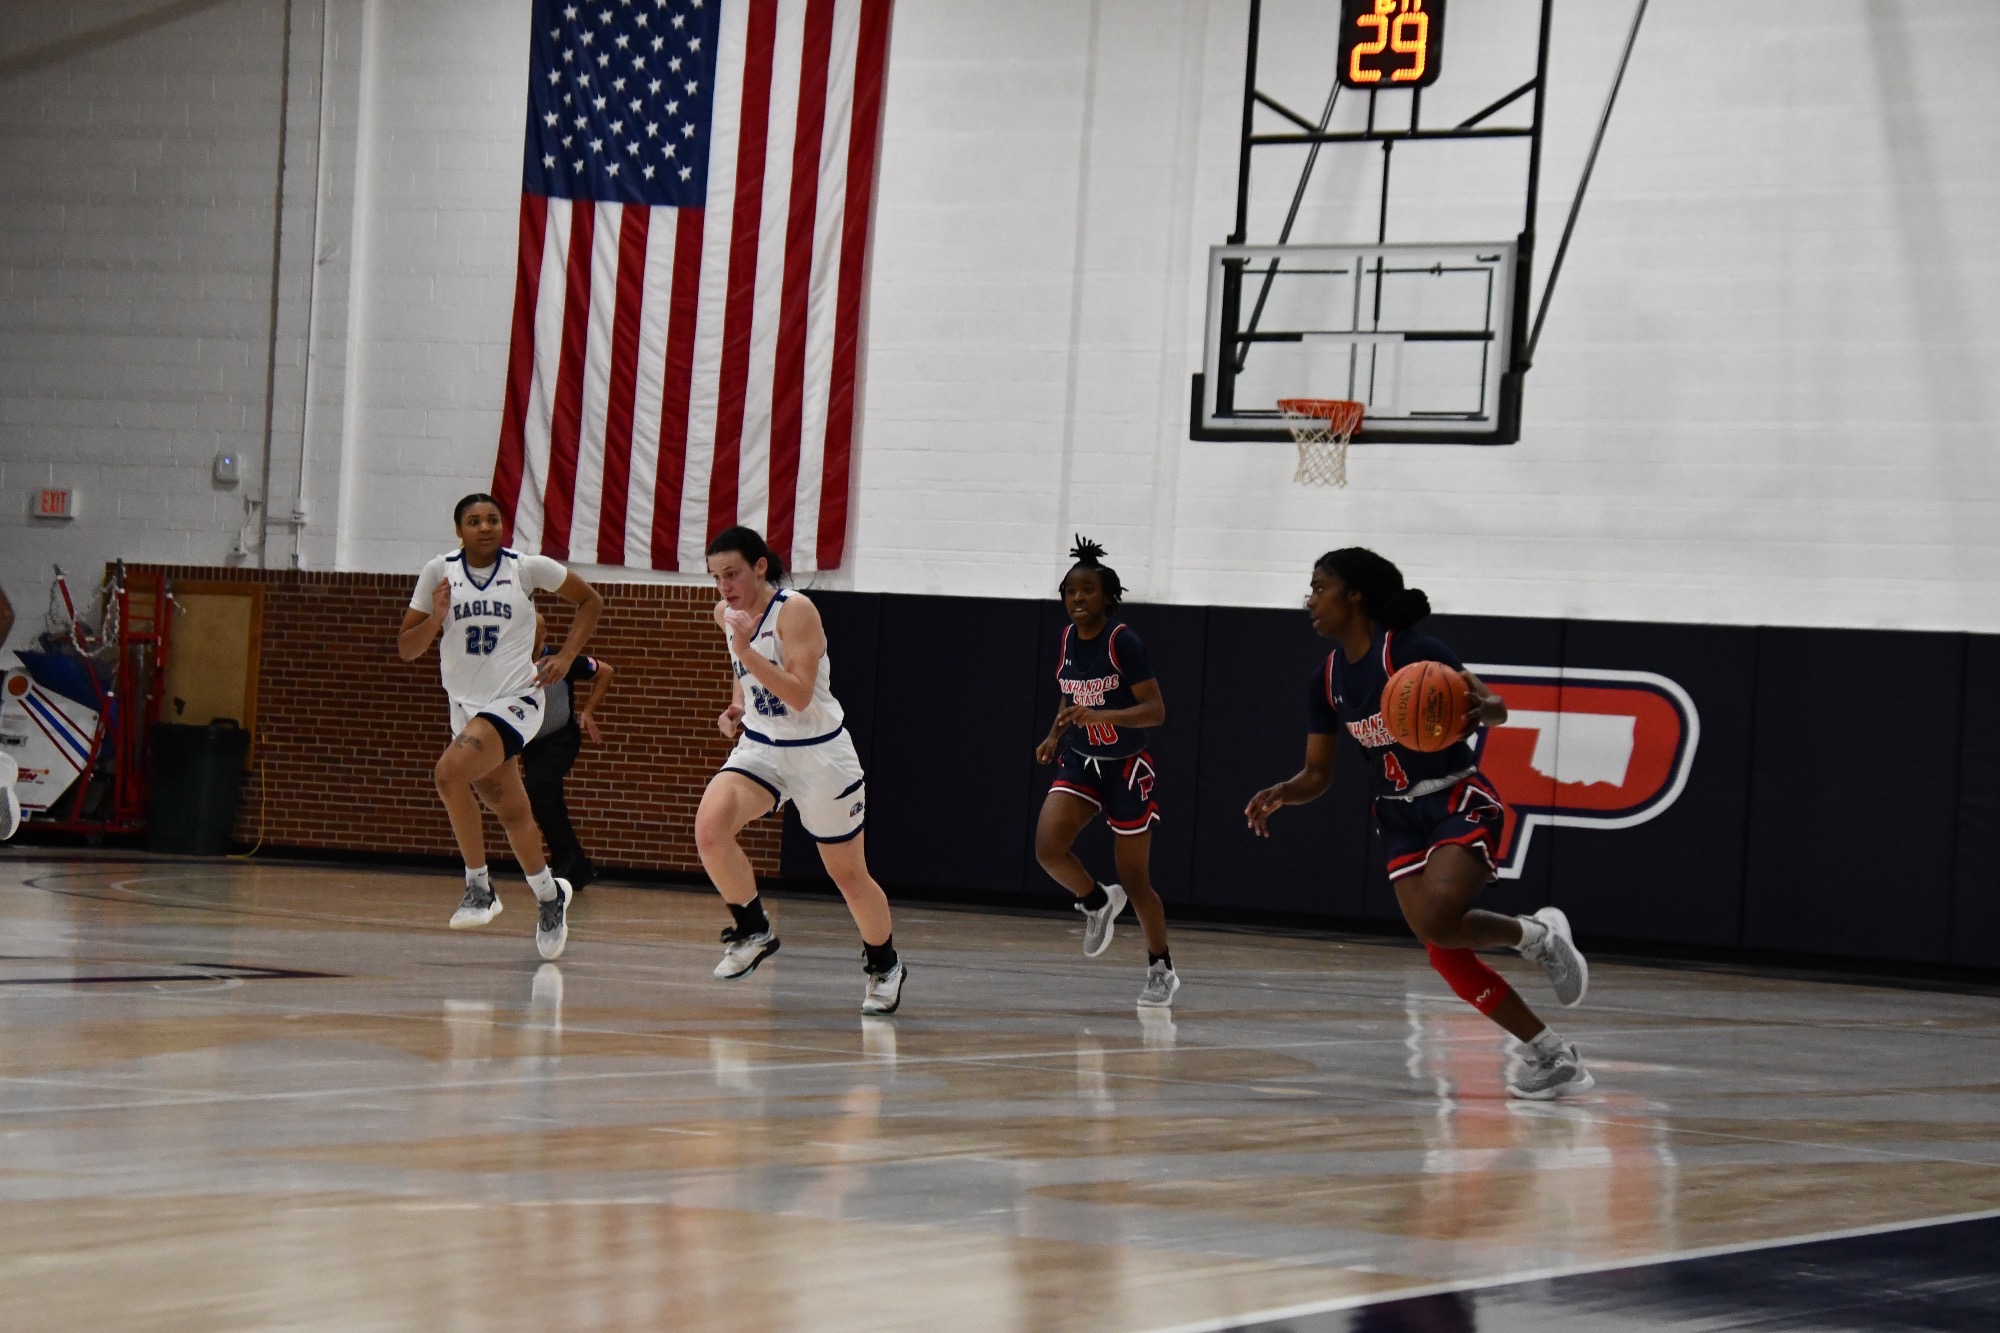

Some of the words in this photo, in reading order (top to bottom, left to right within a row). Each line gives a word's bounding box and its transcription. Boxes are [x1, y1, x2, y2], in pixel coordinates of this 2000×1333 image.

[1349, 11, 1428, 82] 29
[41, 489, 68, 513] EXIT
[453, 600, 512, 621] EAGLES
[465, 625, 500, 655] 25
[750, 685, 788, 717] 22
[1073, 693, 1105, 706] STATE
[1085, 722, 1119, 746] 10
[1384, 751, 1409, 791] 4
